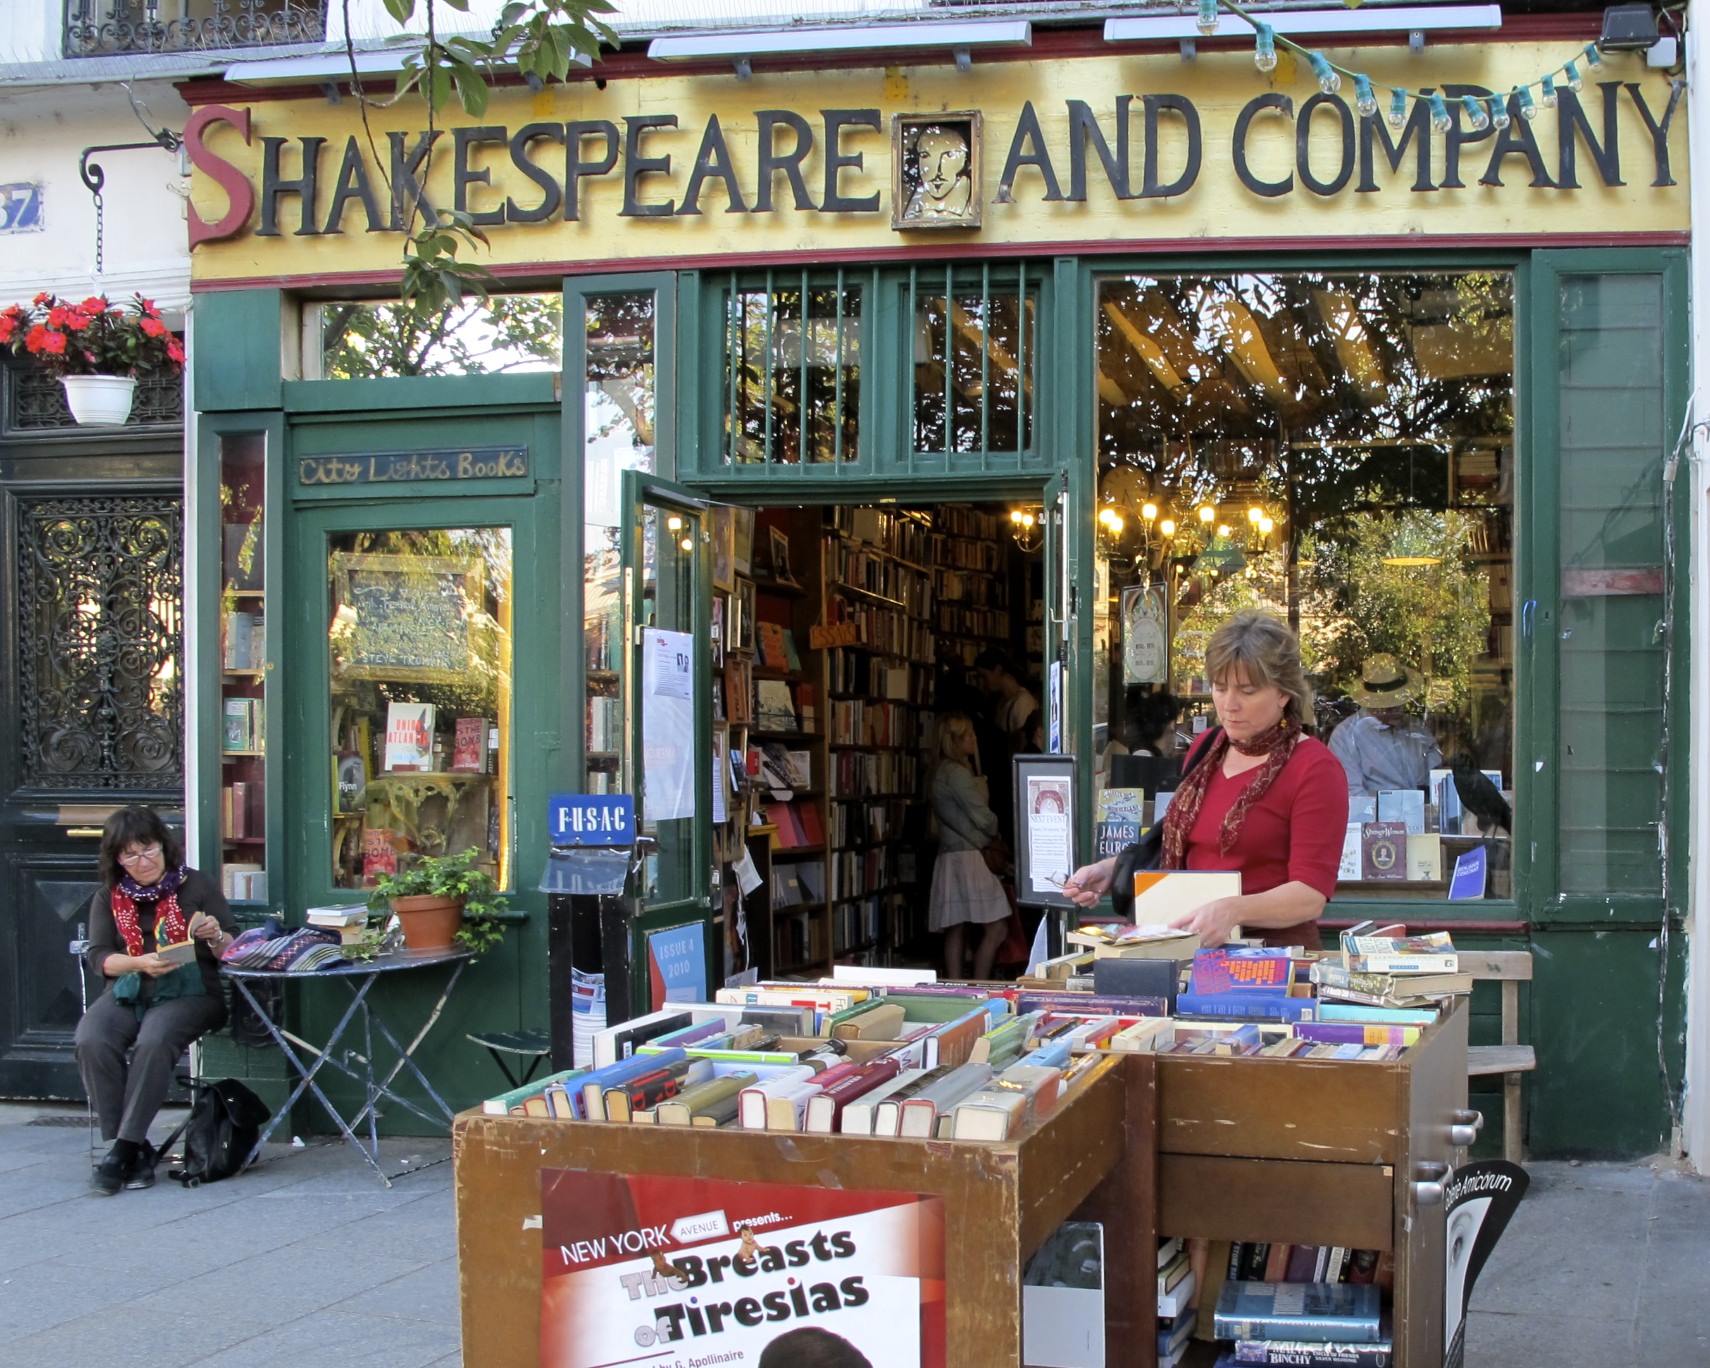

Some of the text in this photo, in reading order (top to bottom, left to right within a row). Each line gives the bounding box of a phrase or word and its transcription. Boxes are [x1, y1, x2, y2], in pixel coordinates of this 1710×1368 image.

[183, 81, 1687, 252] SHAKESPEARE AND COMPANY
[369, 454, 450, 482] Lights
[338, 781, 358, 792] Flynn
[1100, 824, 1135, 840] JAMES
[660, 940, 687, 960] ISSUE
[668, 959, 690, 979] 2010
[1460, 1170, 1512, 1197] Amicorum
[560, 1240, 606, 1266] NEW
[609, 1224, 671, 1256] YORK
[680, 1221, 719, 1237] AVENUE
[620, 1229, 857, 1301] The Breasts
[634, 1275, 870, 1347] of Tiresias
[688, 1350, 745, 1368] Apollinaire
[1269, 1352, 1312, 1365] BINCHY
